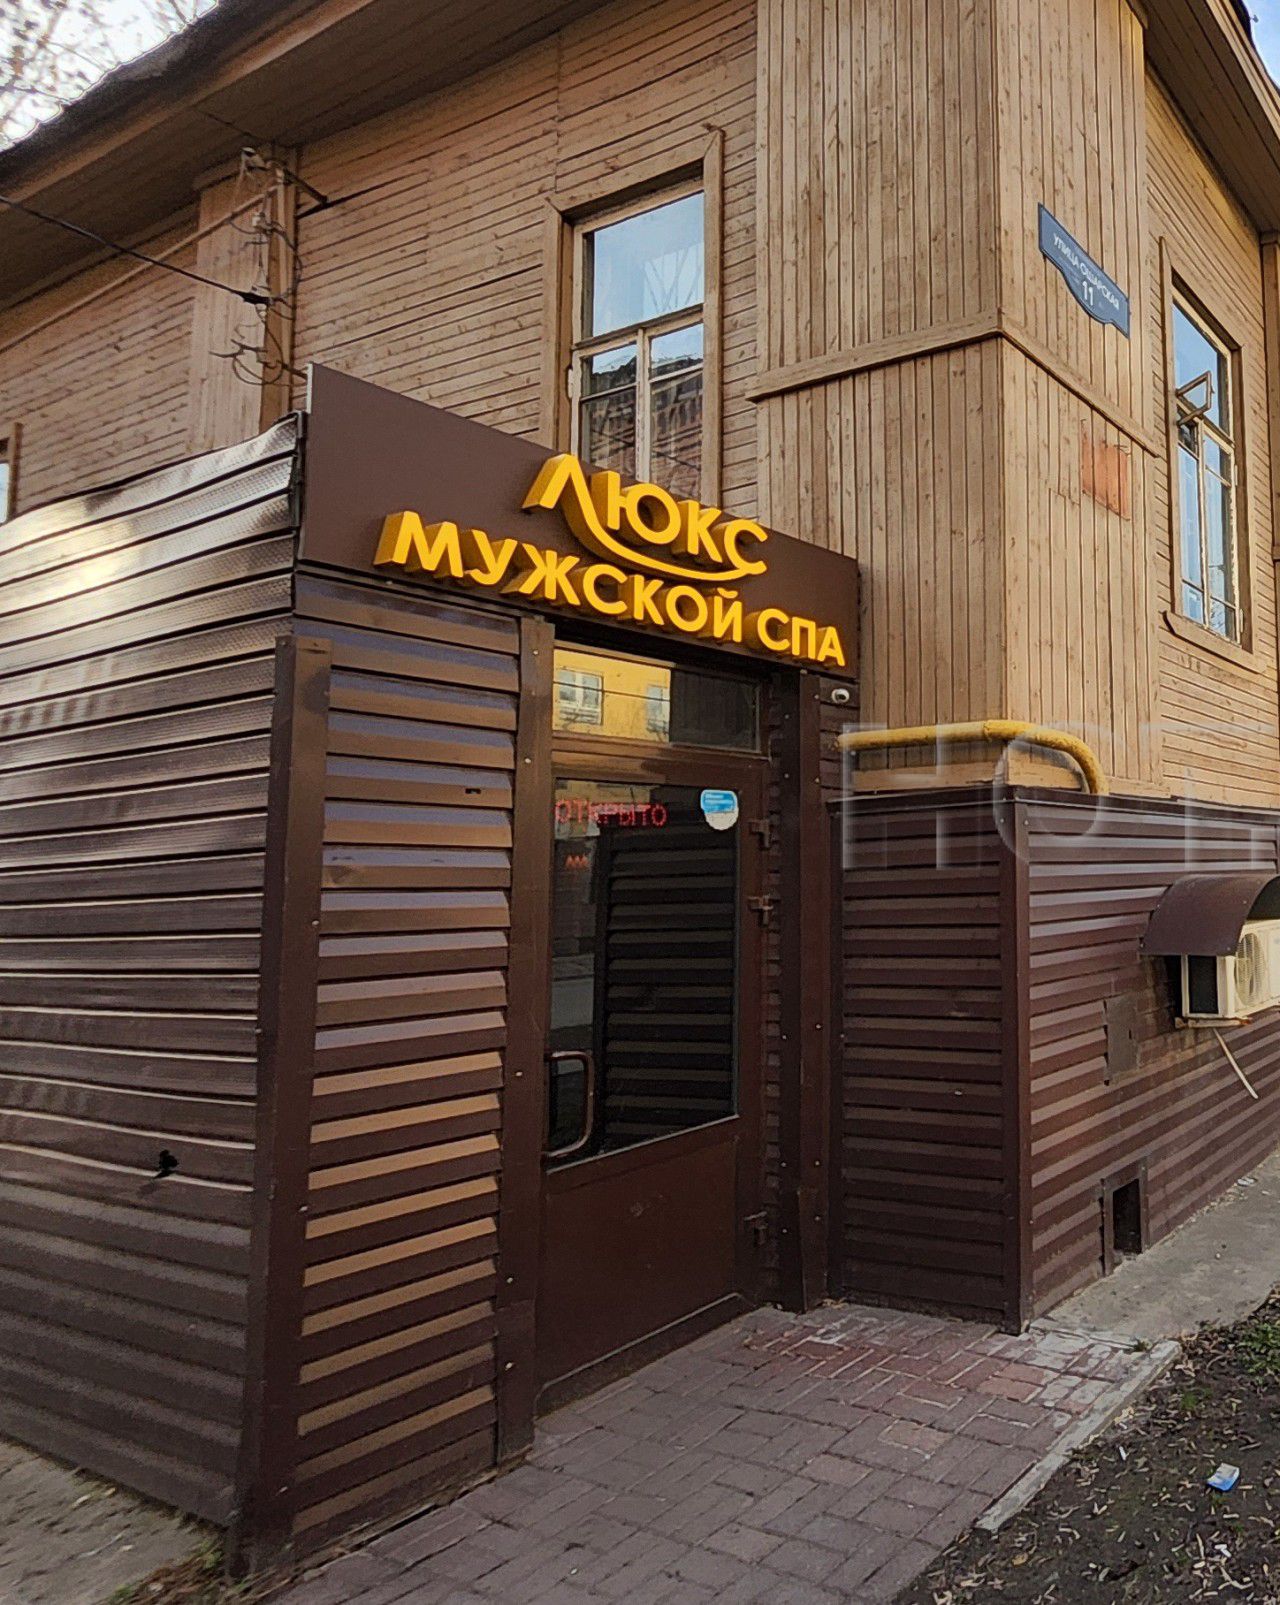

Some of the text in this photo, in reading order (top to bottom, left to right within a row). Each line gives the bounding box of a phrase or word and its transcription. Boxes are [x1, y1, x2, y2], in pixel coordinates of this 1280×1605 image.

[1053, 233, 1079, 269] УЛИЦА
[1082, 281, 1094, 306] 11
[522, 453, 769, 581] ЛЮКС
[375, 510, 846, 667] МУЖСКОЙ СПА
[554, 799, 668, 828] ОТКРЫТО
